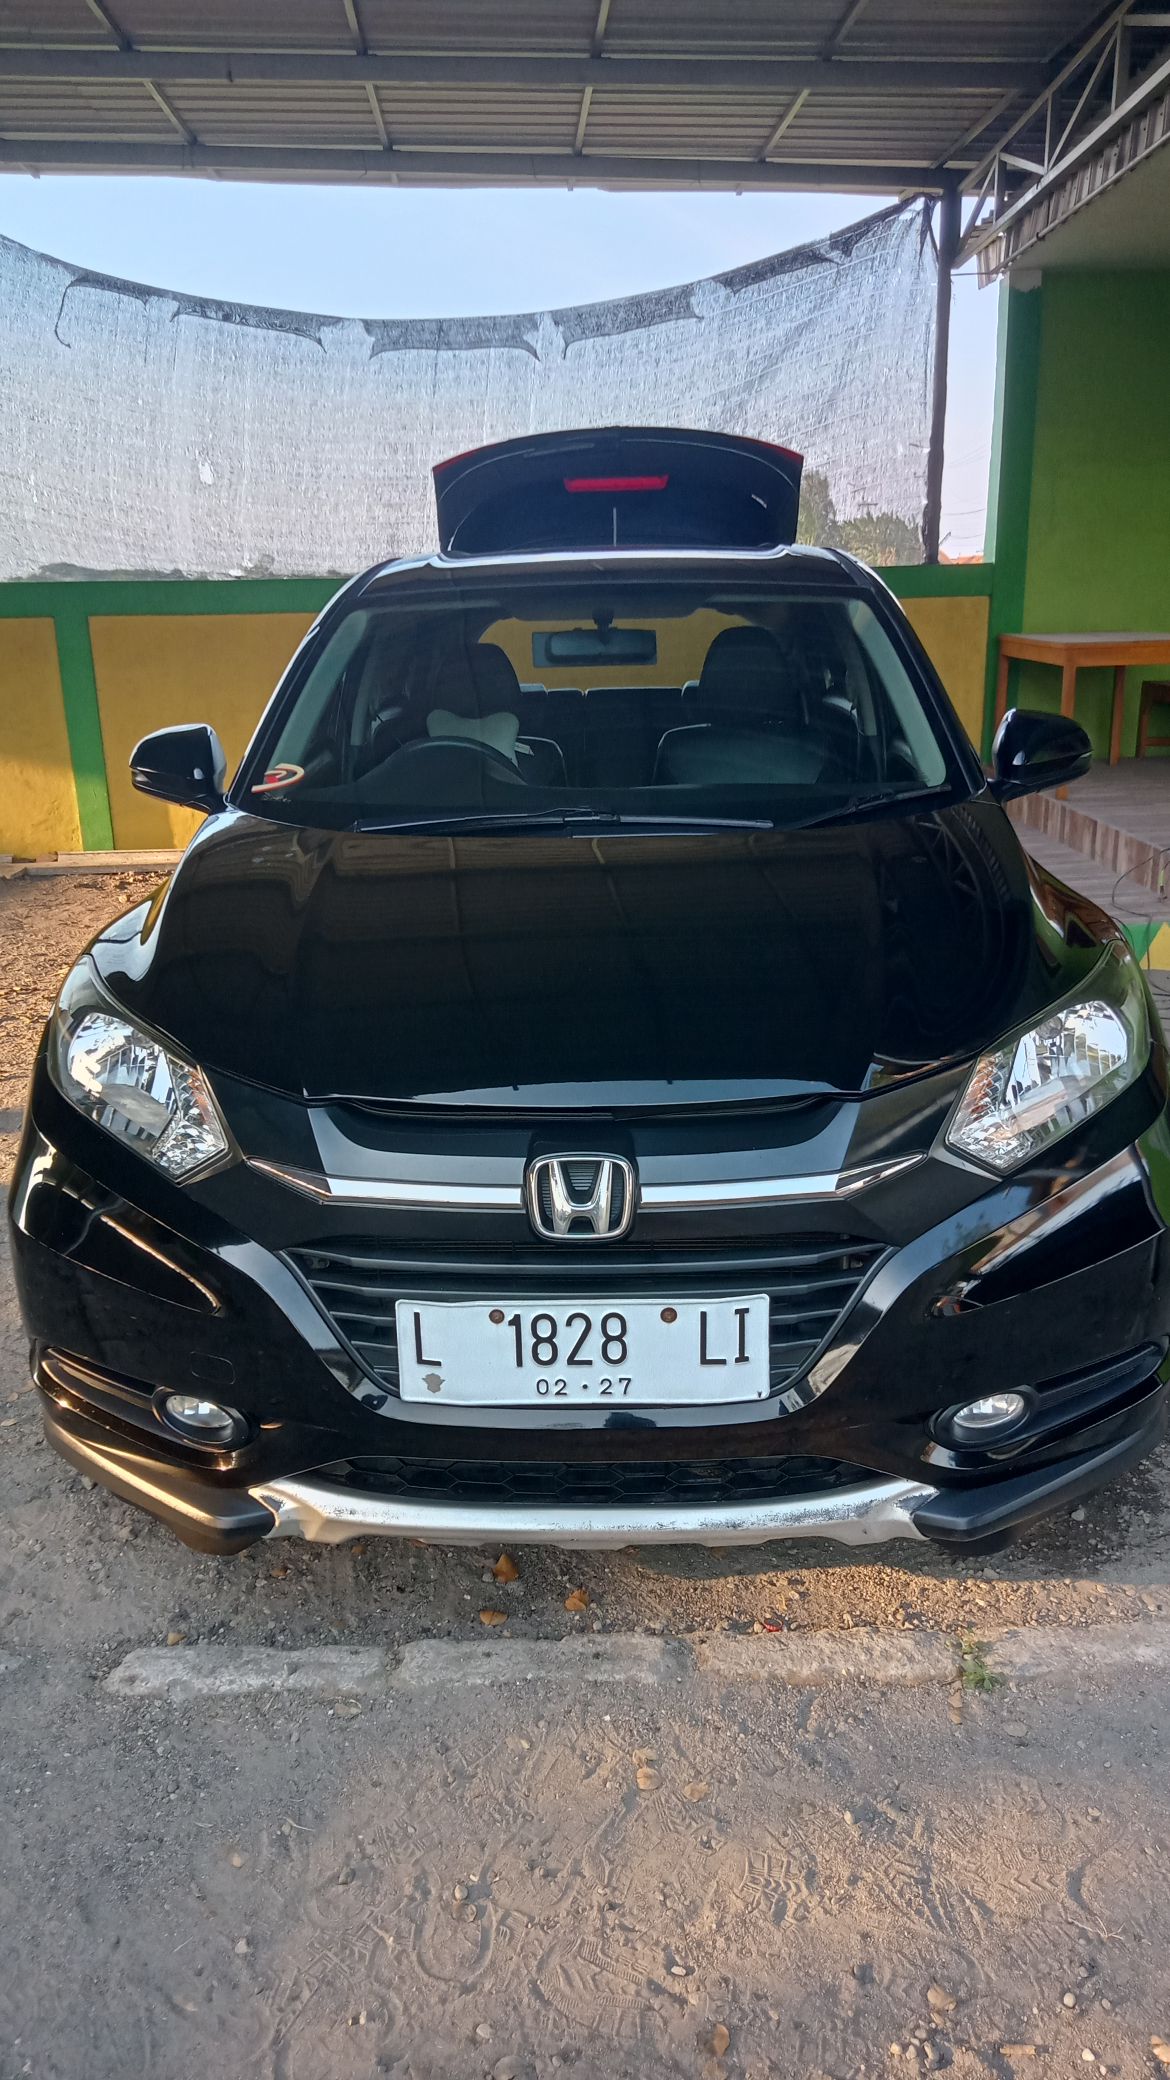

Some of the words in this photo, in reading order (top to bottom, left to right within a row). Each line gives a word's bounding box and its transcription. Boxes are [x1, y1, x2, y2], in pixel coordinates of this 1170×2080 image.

[413, 1311, 442, 1367] L
[507, 1312, 628, 1367] 1828
[699, 1307, 750, 1365] LI
